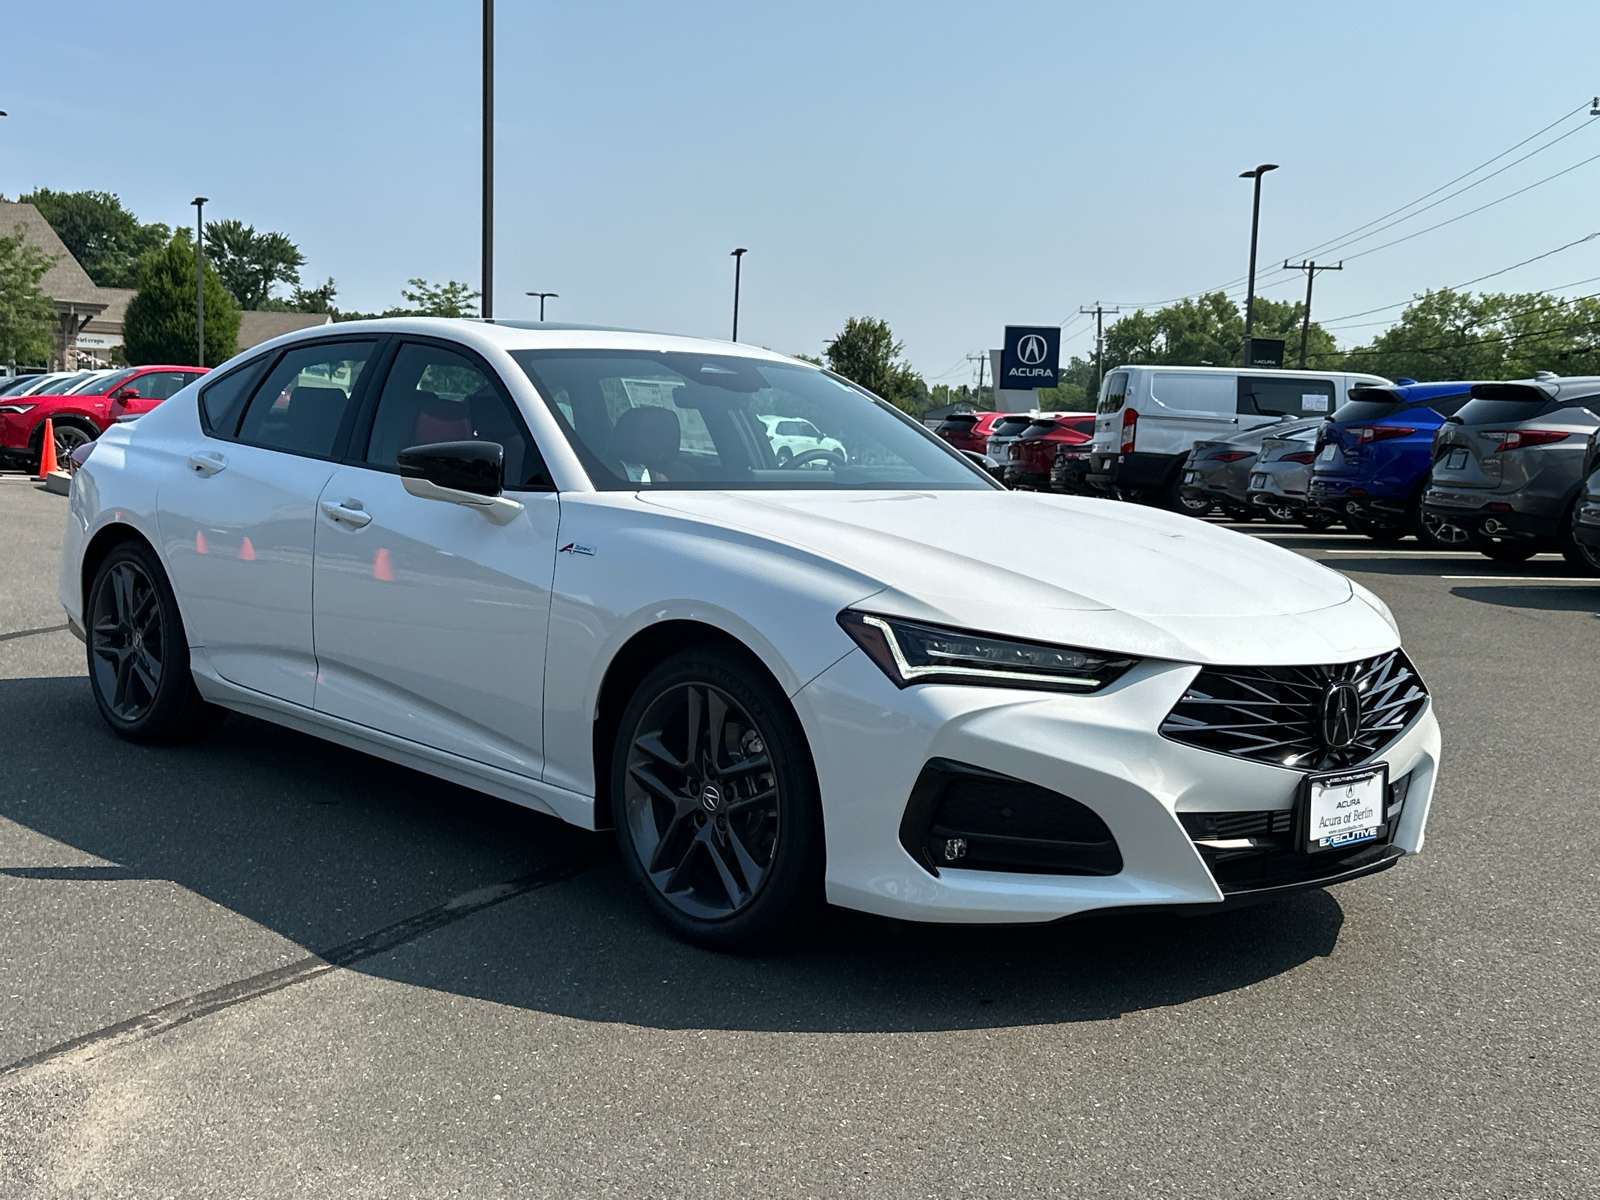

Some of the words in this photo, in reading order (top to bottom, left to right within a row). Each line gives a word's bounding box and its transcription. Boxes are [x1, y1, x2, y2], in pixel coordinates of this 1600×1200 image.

[1008, 367, 1053, 378] ACURA
[1336, 798, 1361, 809] ACURA
[1319, 815, 1342, 828] Acura
[1343, 811, 1353, 823] of
[1353, 807, 1374, 821] Berlin
[1319, 827, 1377, 847] EXECUTIVE
